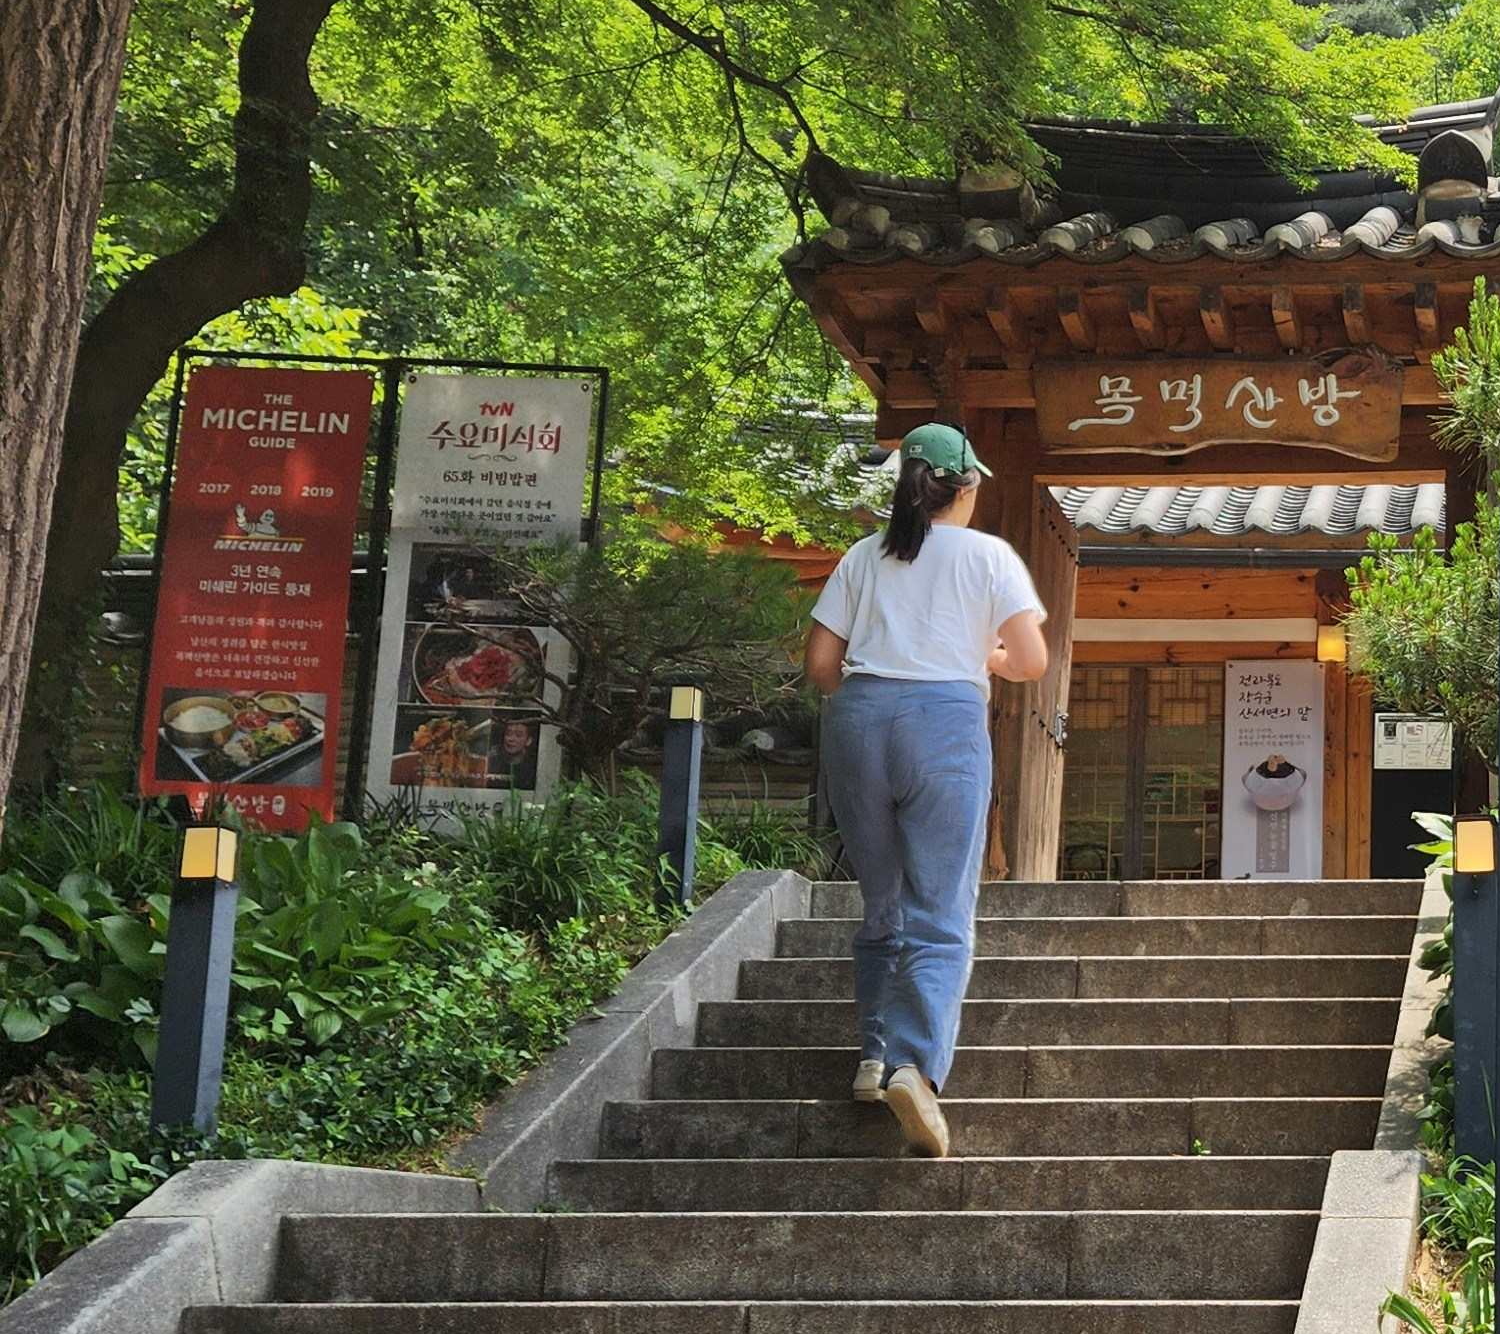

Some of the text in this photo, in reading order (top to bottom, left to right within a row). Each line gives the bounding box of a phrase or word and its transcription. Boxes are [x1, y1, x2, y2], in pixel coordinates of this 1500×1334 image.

[263, 393, 293, 405] THE
[1068, 373, 1362, 433] 목멱산방
[479, 401, 515, 417] tvN
[201, 407, 350, 435] MICHELIN
[249, 436, 296, 449] GUIDE
[427, 420, 561, 454] 수요미식회
[443, 470, 537, 487] 65화 비빔밥편
[199, 482, 334, 498] 2017 2018 2019
[213, 539, 303, 553] MICHELIN
[230, 564, 282, 579] 3년 연속
[199, 580, 237, 594] 미쉐린
[242, 581, 281, 595] 가이드
[1239, 673, 1282, 689] 전라북도
[1239, 691, 1272, 705] 장수군
